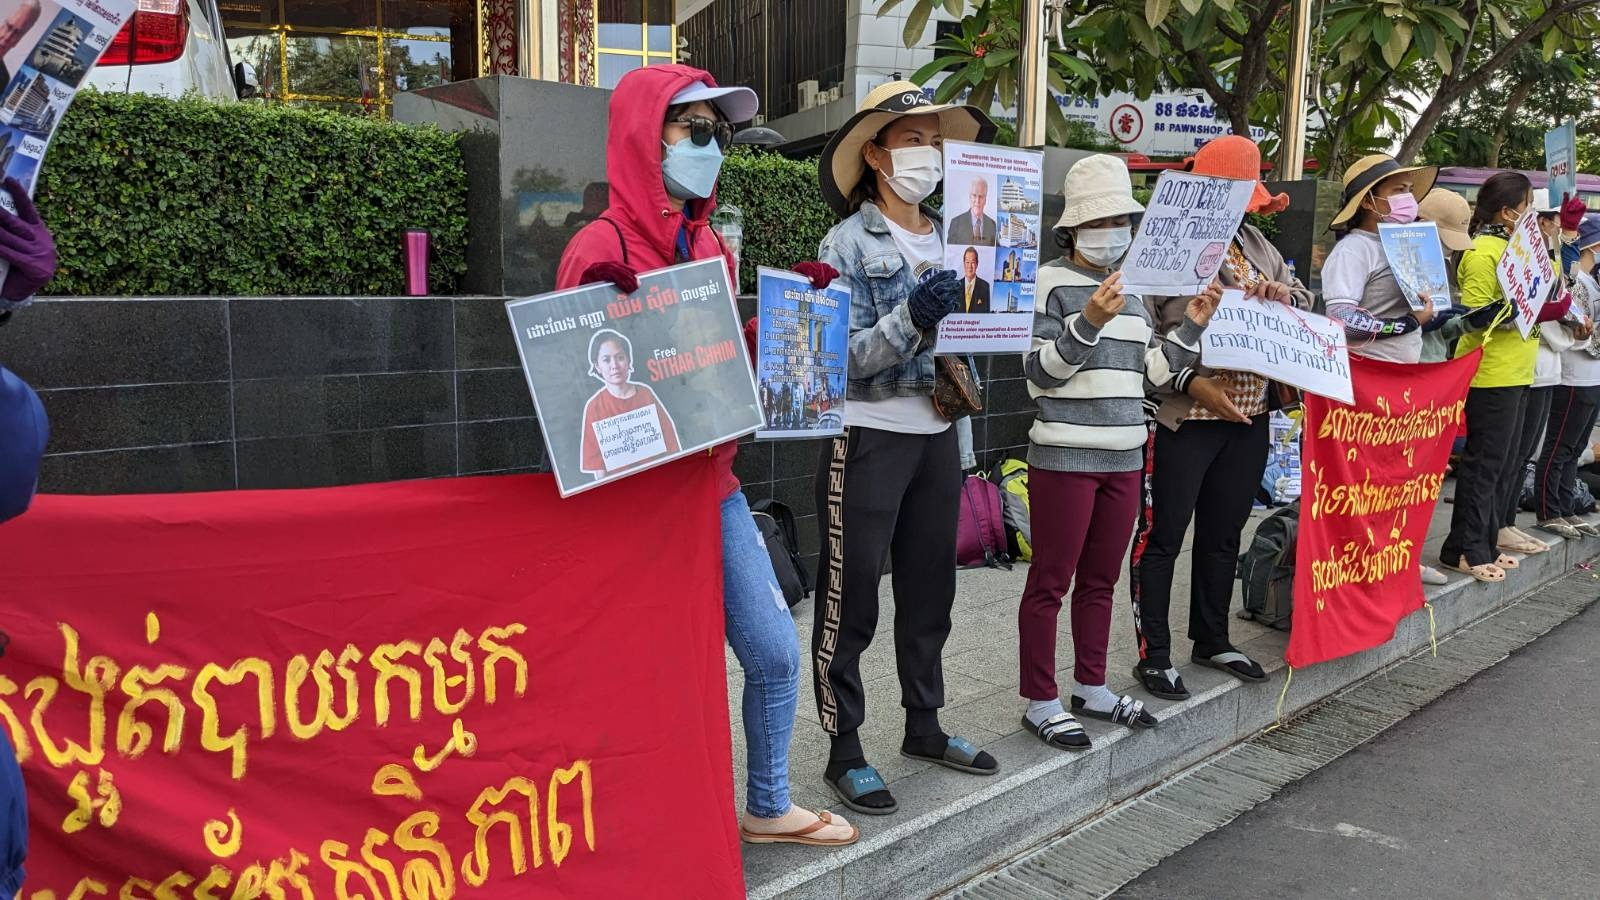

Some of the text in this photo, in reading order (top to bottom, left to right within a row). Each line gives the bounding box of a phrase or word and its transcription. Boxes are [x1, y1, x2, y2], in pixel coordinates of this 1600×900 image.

[1155, 122, 1165, 131] 88
[1169, 123, 1223, 135] PAWNSHOP
[22, 139, 43, 154] Naga2
[1013, 166, 1039, 174] Association
[0, 197, 15, 210] Nag
[1514, 284, 1534, 325] RIGHT
[646, 351, 697, 382] SITHAR
[696, 339, 737, 368] CHHIM
[653, 346, 677, 361] Free
